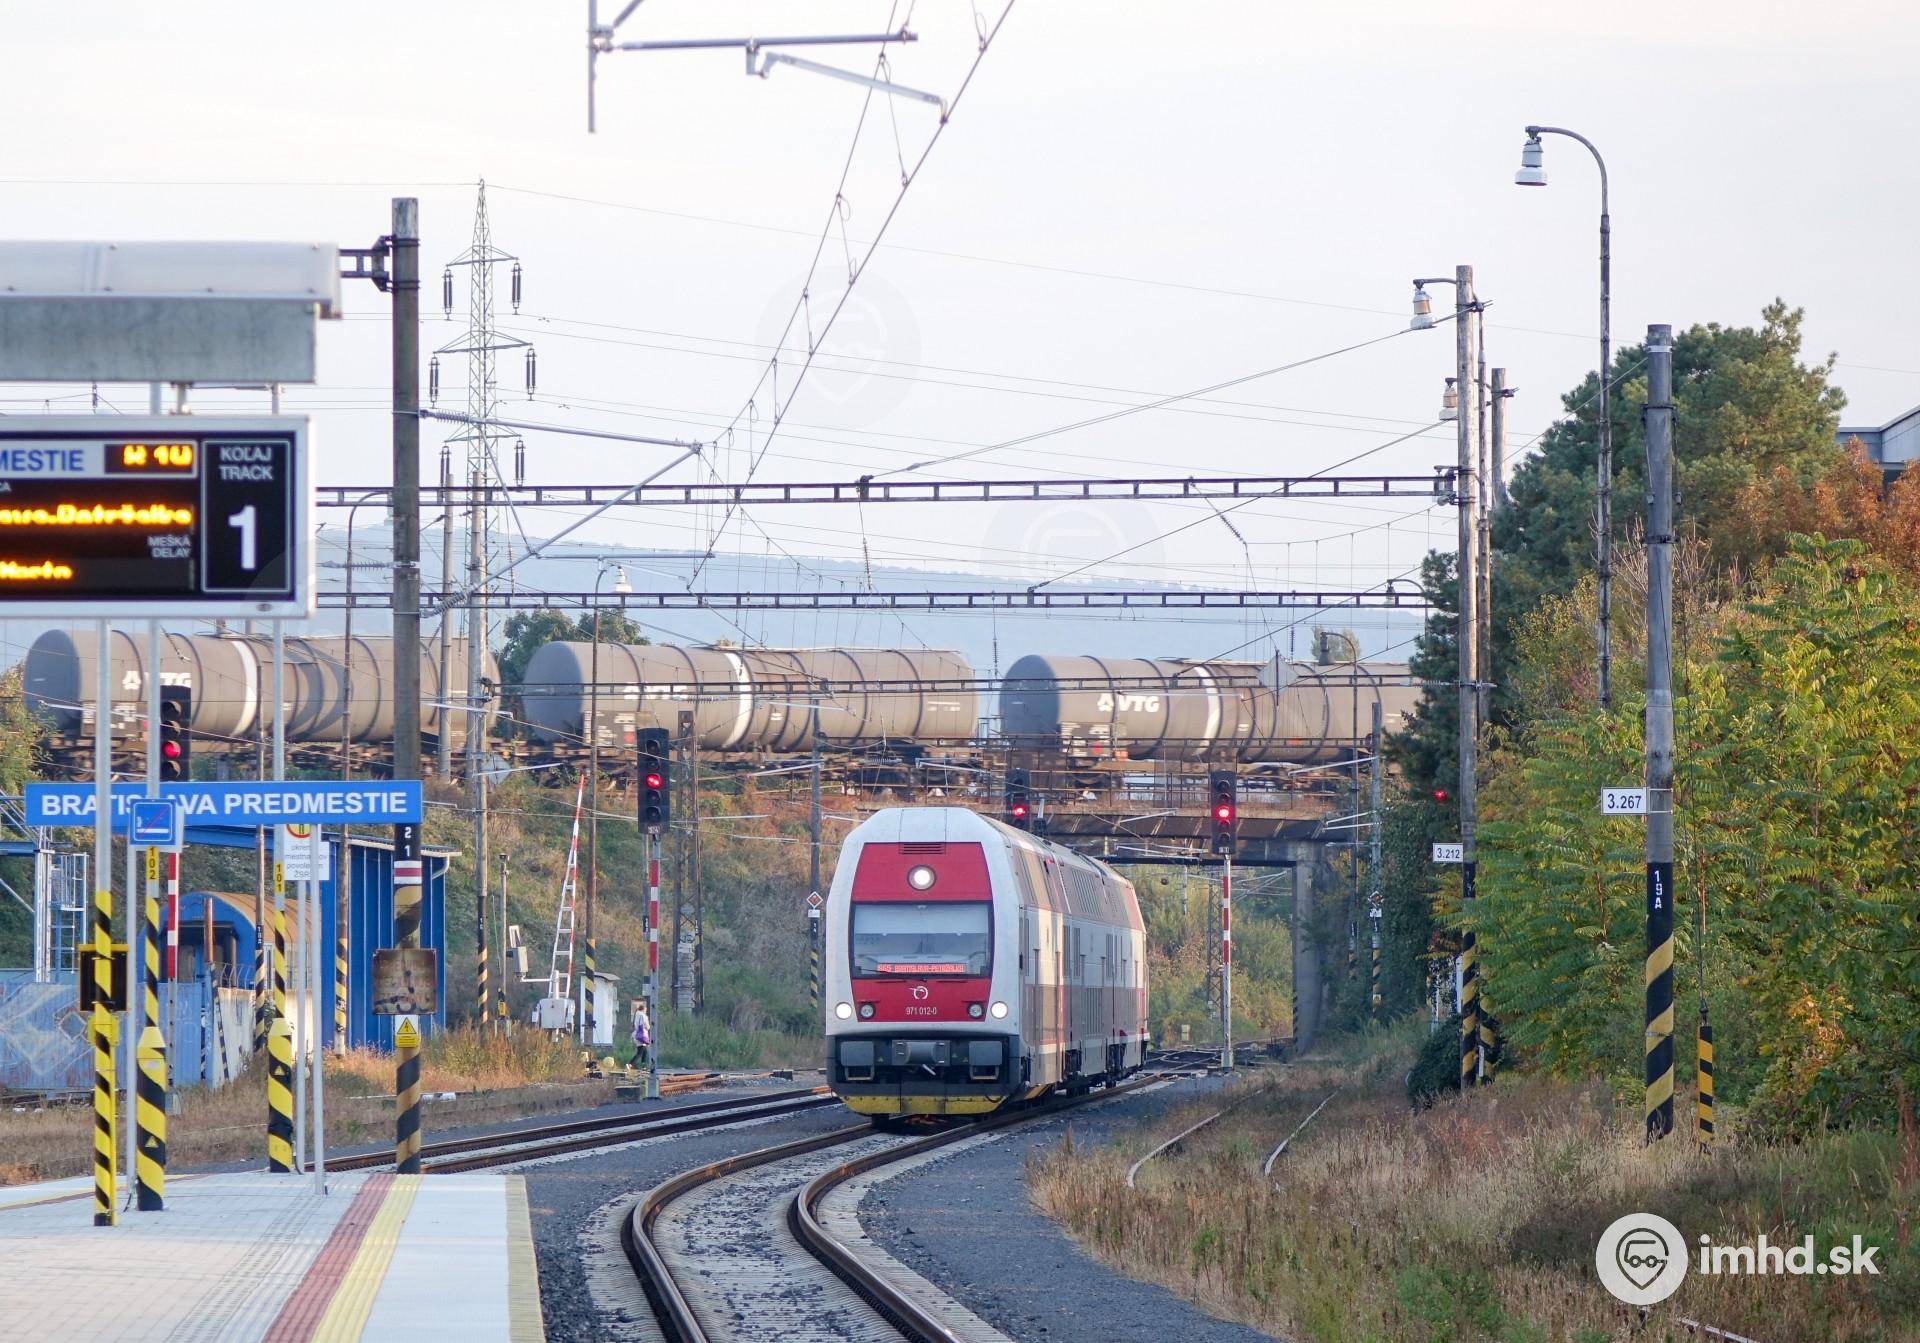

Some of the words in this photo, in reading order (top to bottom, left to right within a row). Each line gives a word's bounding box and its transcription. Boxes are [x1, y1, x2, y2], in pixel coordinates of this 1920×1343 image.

[219, 465, 273, 480] TRACK
[229, 505, 256, 570] 1
[152, 548, 190, 558] DELAY
[1118, 695, 1160, 712] VTG
[224, 792, 408, 815] PREDMESTIE
[1607, 793, 1642, 809] 3.267
[1437, 847, 1460, 859] 3.212
[906, 1006, 917, 1015] 971
[919, 1006, 937, 1015] 012-0
